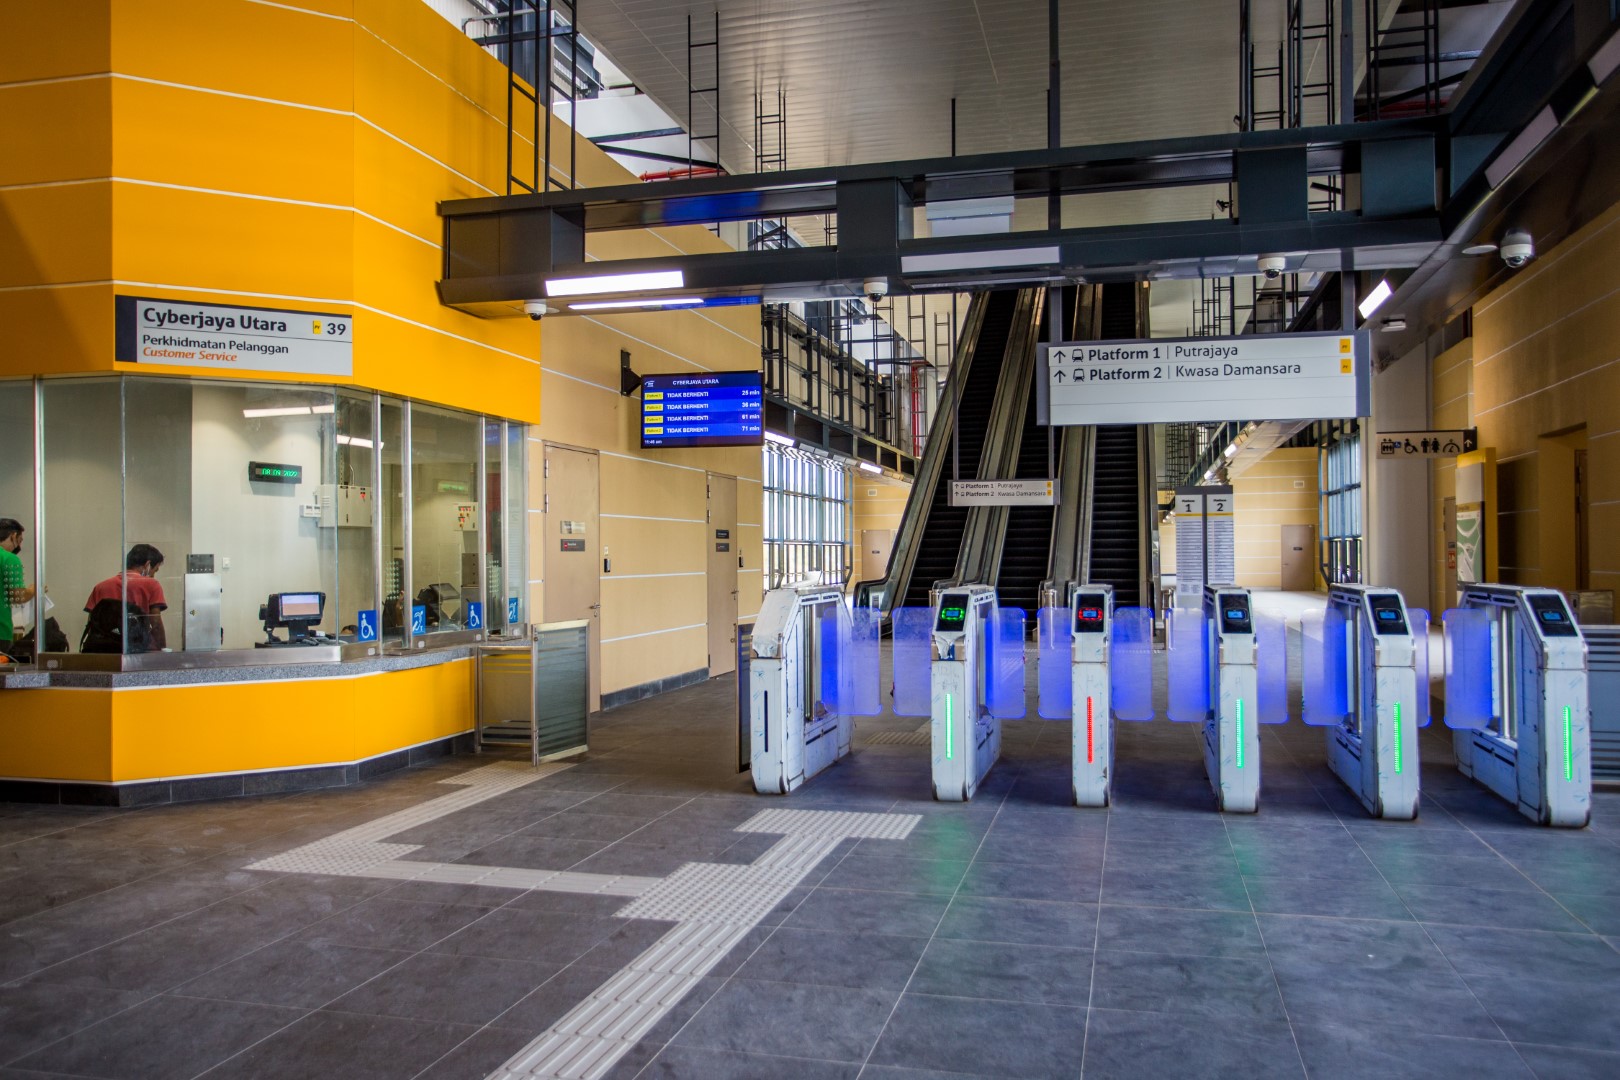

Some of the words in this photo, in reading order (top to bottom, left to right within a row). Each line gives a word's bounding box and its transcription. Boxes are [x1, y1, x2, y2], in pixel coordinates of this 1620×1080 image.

[143, 307, 235, 331] Cyberjaya
[240, 315, 287, 332] Utara
[327, 322, 346, 335] 39
[143, 335, 226, 350] Perkhidmatan
[229, 341, 289, 355] Pelanggan
[143, 347, 195, 360] Customer
[198, 350, 237, 362] Service
[1088, 348, 1149, 362] Platform
[1153, 347, 1160, 359] 1
[1175, 345, 1239, 359] Putrajaya
[1089, 368, 1150, 381] Platform
[1153, 367, 1162, 379] 2
[1175, 365, 1219, 377] Kwasa
[1223, 362, 1301, 376] Damansara
[1186, 504, 1192, 512] 1
[1216, 503, 1224, 511] 2
